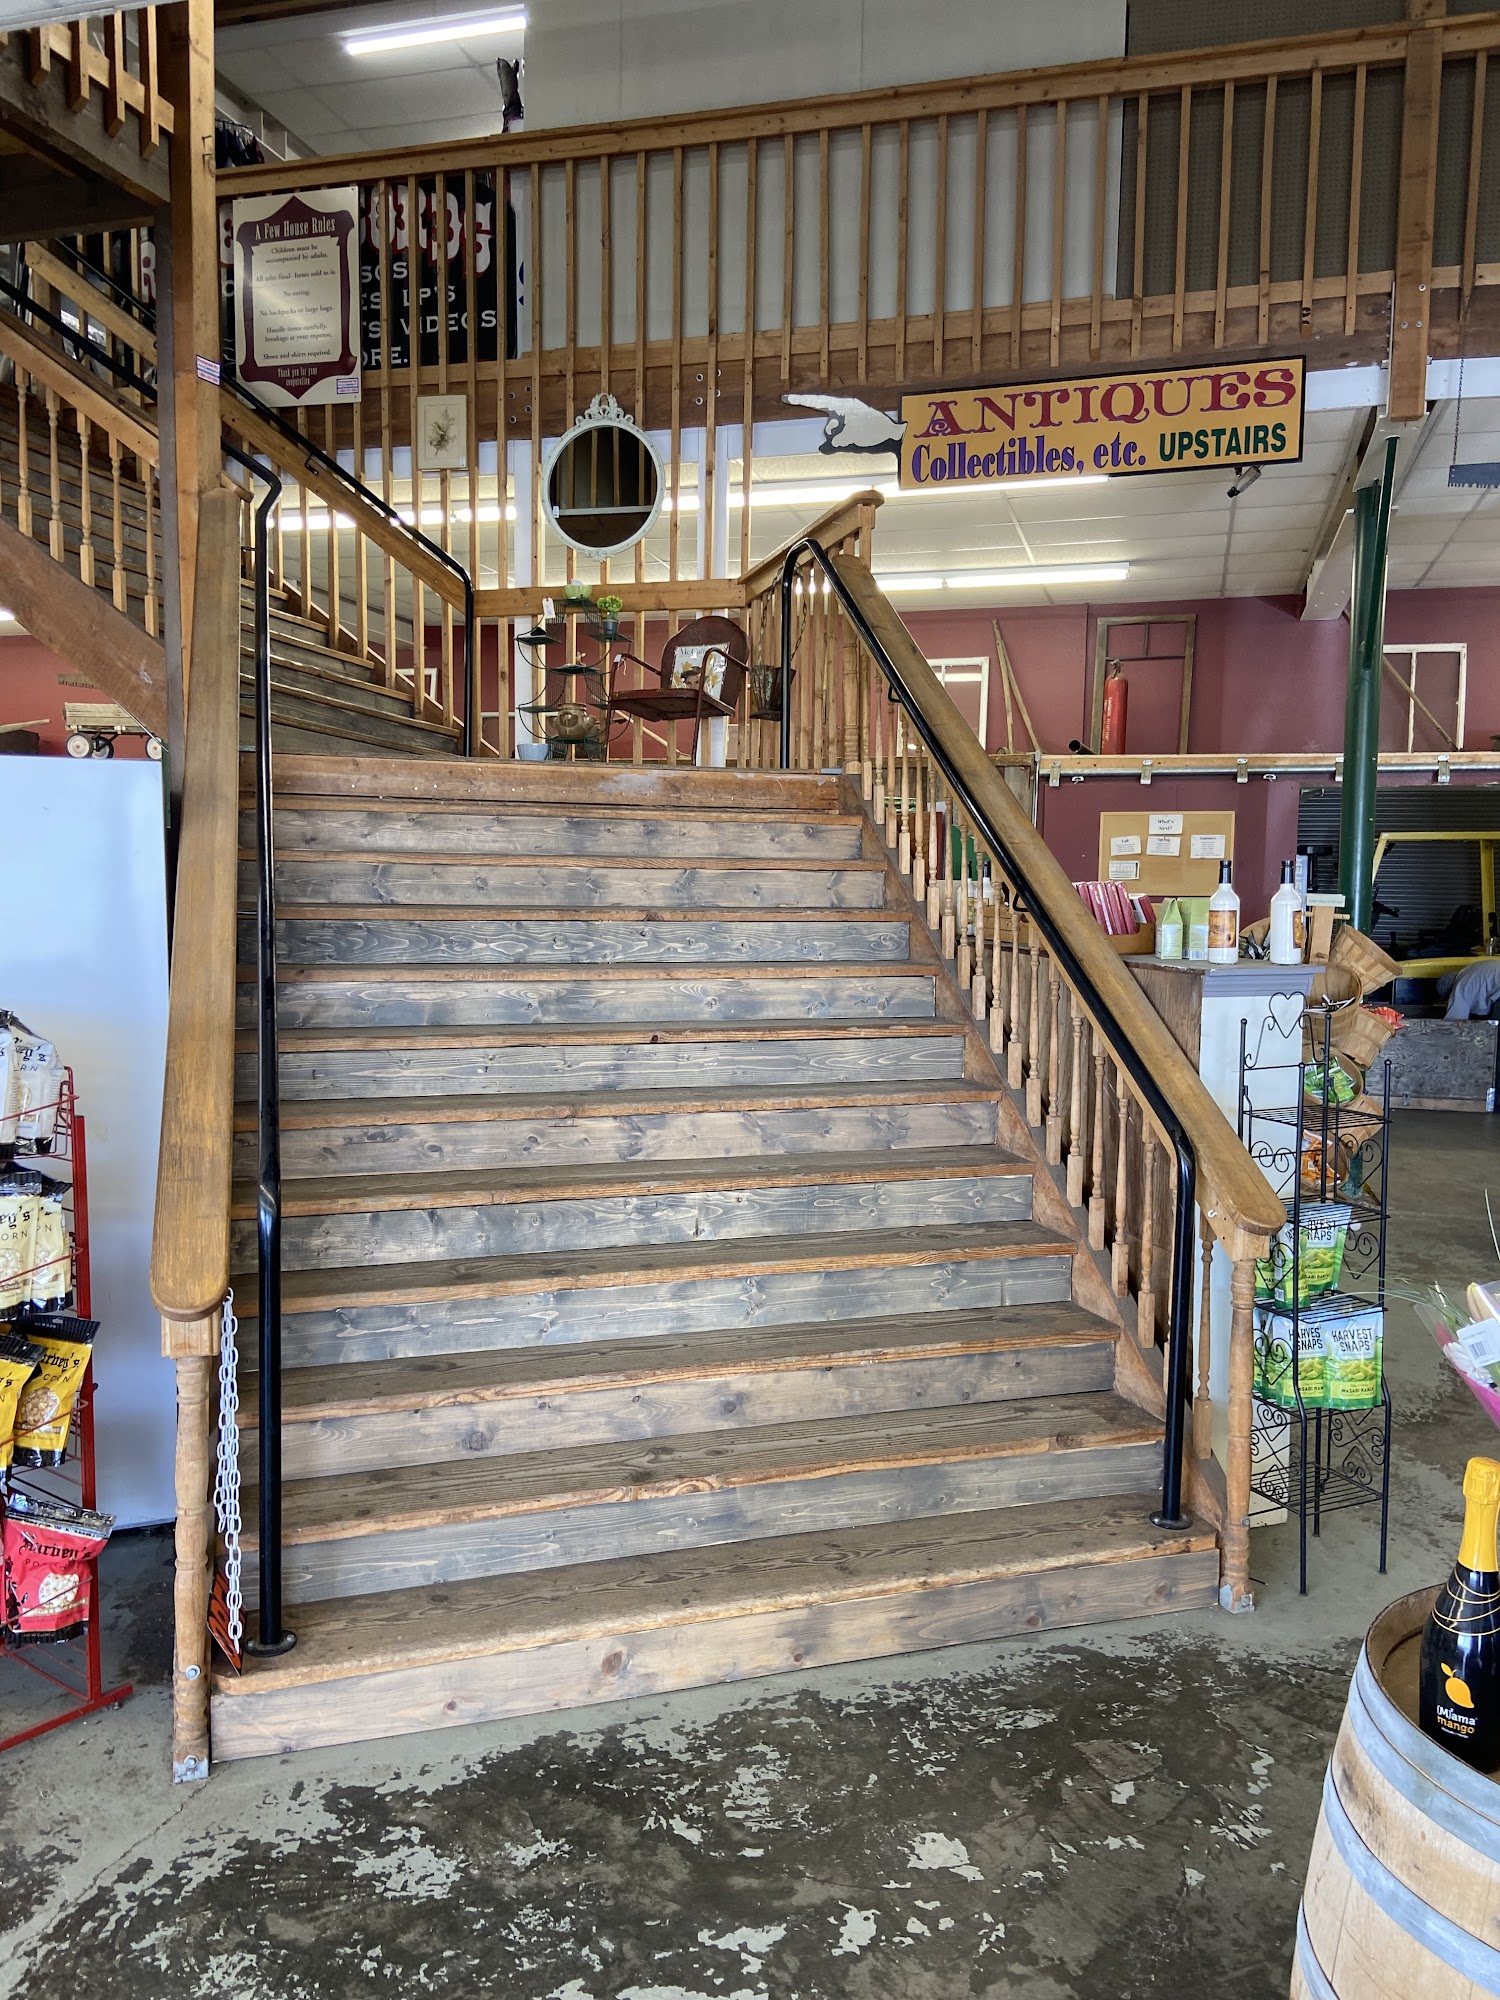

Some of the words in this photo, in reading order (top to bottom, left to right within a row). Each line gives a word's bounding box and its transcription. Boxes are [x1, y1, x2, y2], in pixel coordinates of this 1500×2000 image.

[255, 223, 261, 240] A
[264, 222, 281, 239] Few
[283, 220, 309, 237] House
[311, 216, 336, 234] Rules
[271, 246, 295, 255] Children
[297, 244, 310, 252] must
[311, 243, 318, 251] be
[266, 255, 301, 264] accompanied
[302, 254, 309, 262] by
[265, 274, 277, 282] sales
[310, 269, 322, 277] sold
[292, 289, 311, 297] eating.
[260, 309, 268, 317] No
[269, 307, 297, 317] backpacks
[305, 306, 319, 315] large
[266, 326, 286, 334] Handle
[264, 335, 288, 344] breakage
[296, 334, 309, 342] your
[291, 350, 307, 358] shirts
[277, 367, 290, 378] Thank
[291, 368, 300, 378] you
[308, 367, 318, 376] your
[285, 377, 310, 388] cooperation
[913, 367, 1296, 439] ANTIQUES
[911, 434, 1085, 483] Collectibles,
[1092, 431, 1147, 469] etc.
[1158, 422, 1287, 462] UPSTAIRS
[1331, 1328, 1373, 1342] HARVEST
[1340, 1340, 1370, 1352] SNAPS
[1437, 1715, 1475, 1734] mango
